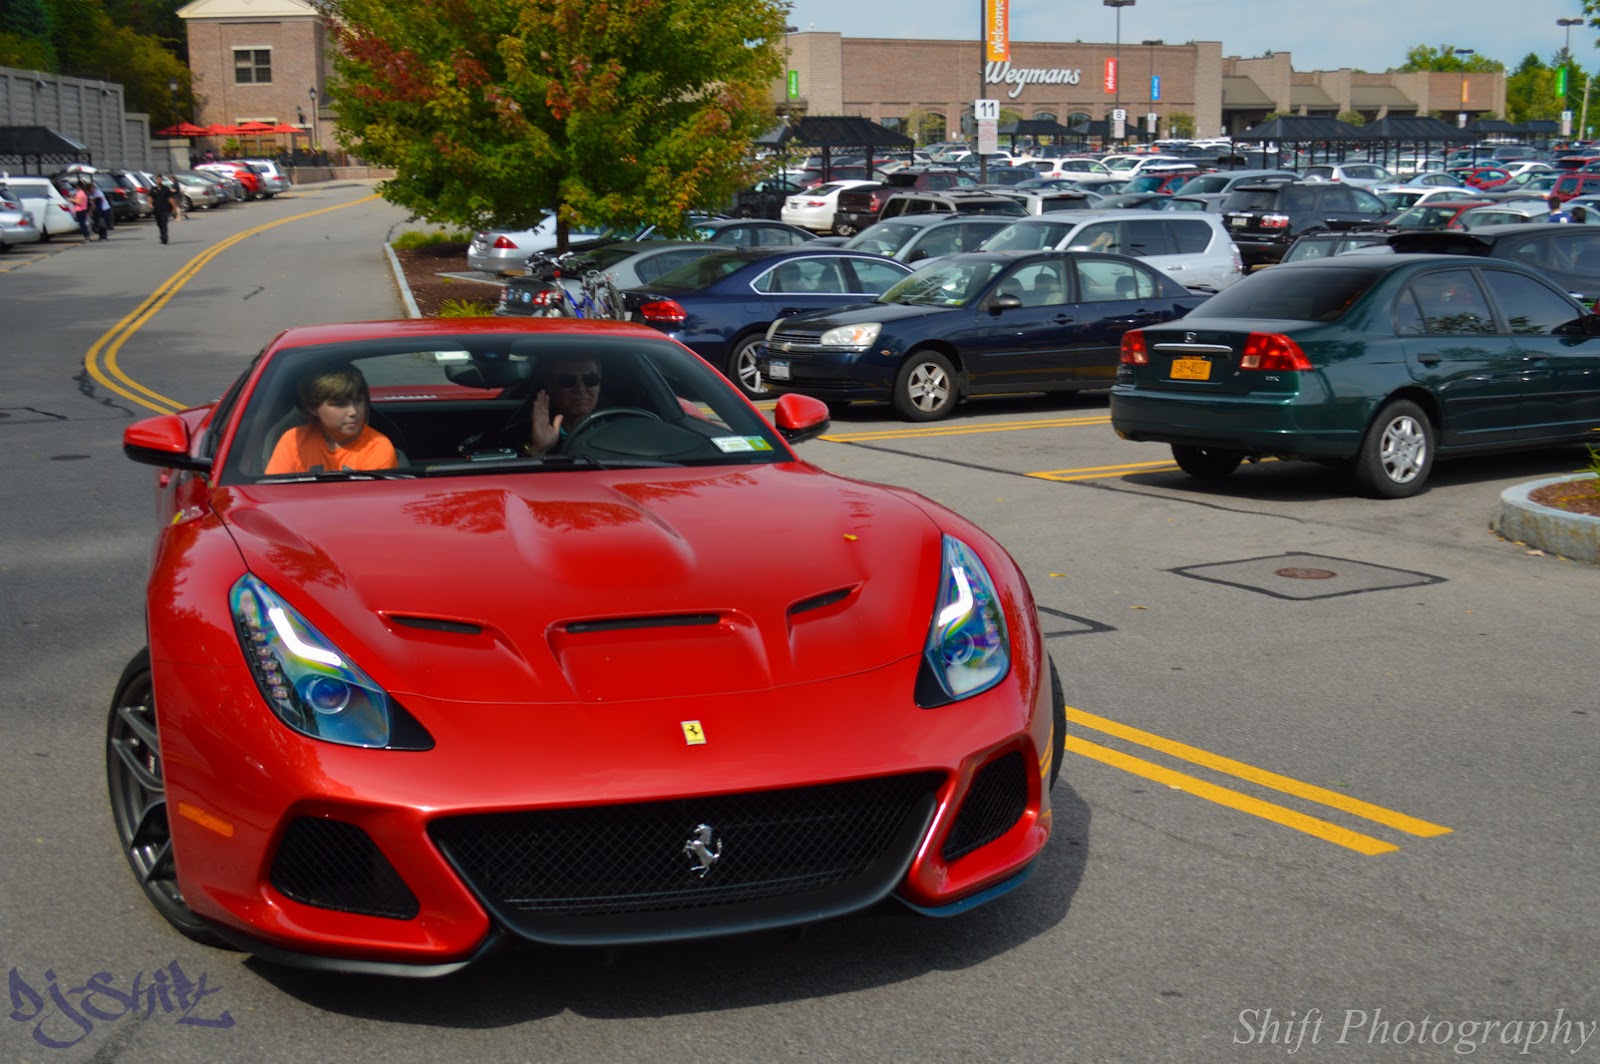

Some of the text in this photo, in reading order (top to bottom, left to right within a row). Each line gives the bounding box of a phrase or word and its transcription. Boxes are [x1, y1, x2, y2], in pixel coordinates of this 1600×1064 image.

[990, 0, 1005, 53] Welcome
[985, 60, 1081, 98] Wegmans
[981, 102, 995, 117] 11
